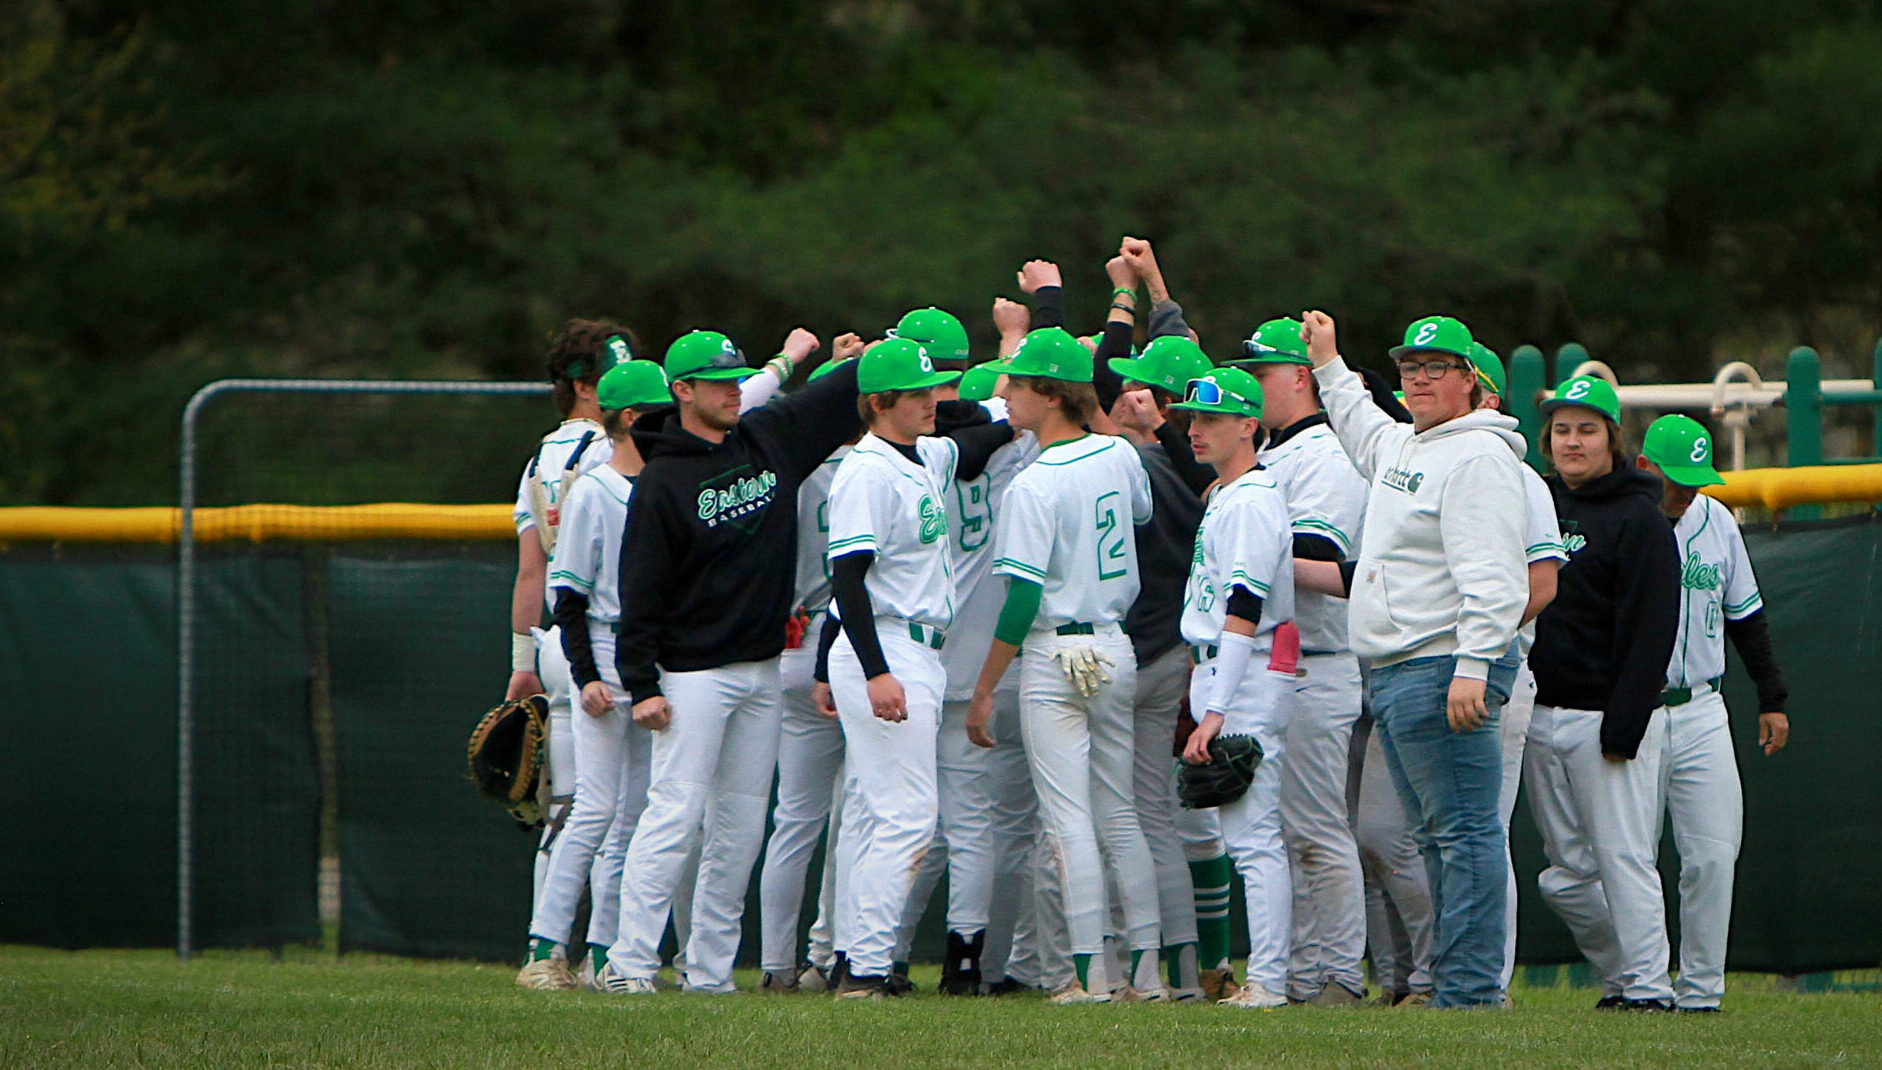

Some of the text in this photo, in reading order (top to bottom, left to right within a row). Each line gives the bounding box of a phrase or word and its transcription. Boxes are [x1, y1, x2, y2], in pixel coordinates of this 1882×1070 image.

[1414, 322, 1438, 346] E
[1565, 380, 1591, 400] E
[1690, 437, 1708, 462] E
[1095, 490, 1129, 582] 2
[1680, 550, 1721, 591] les
